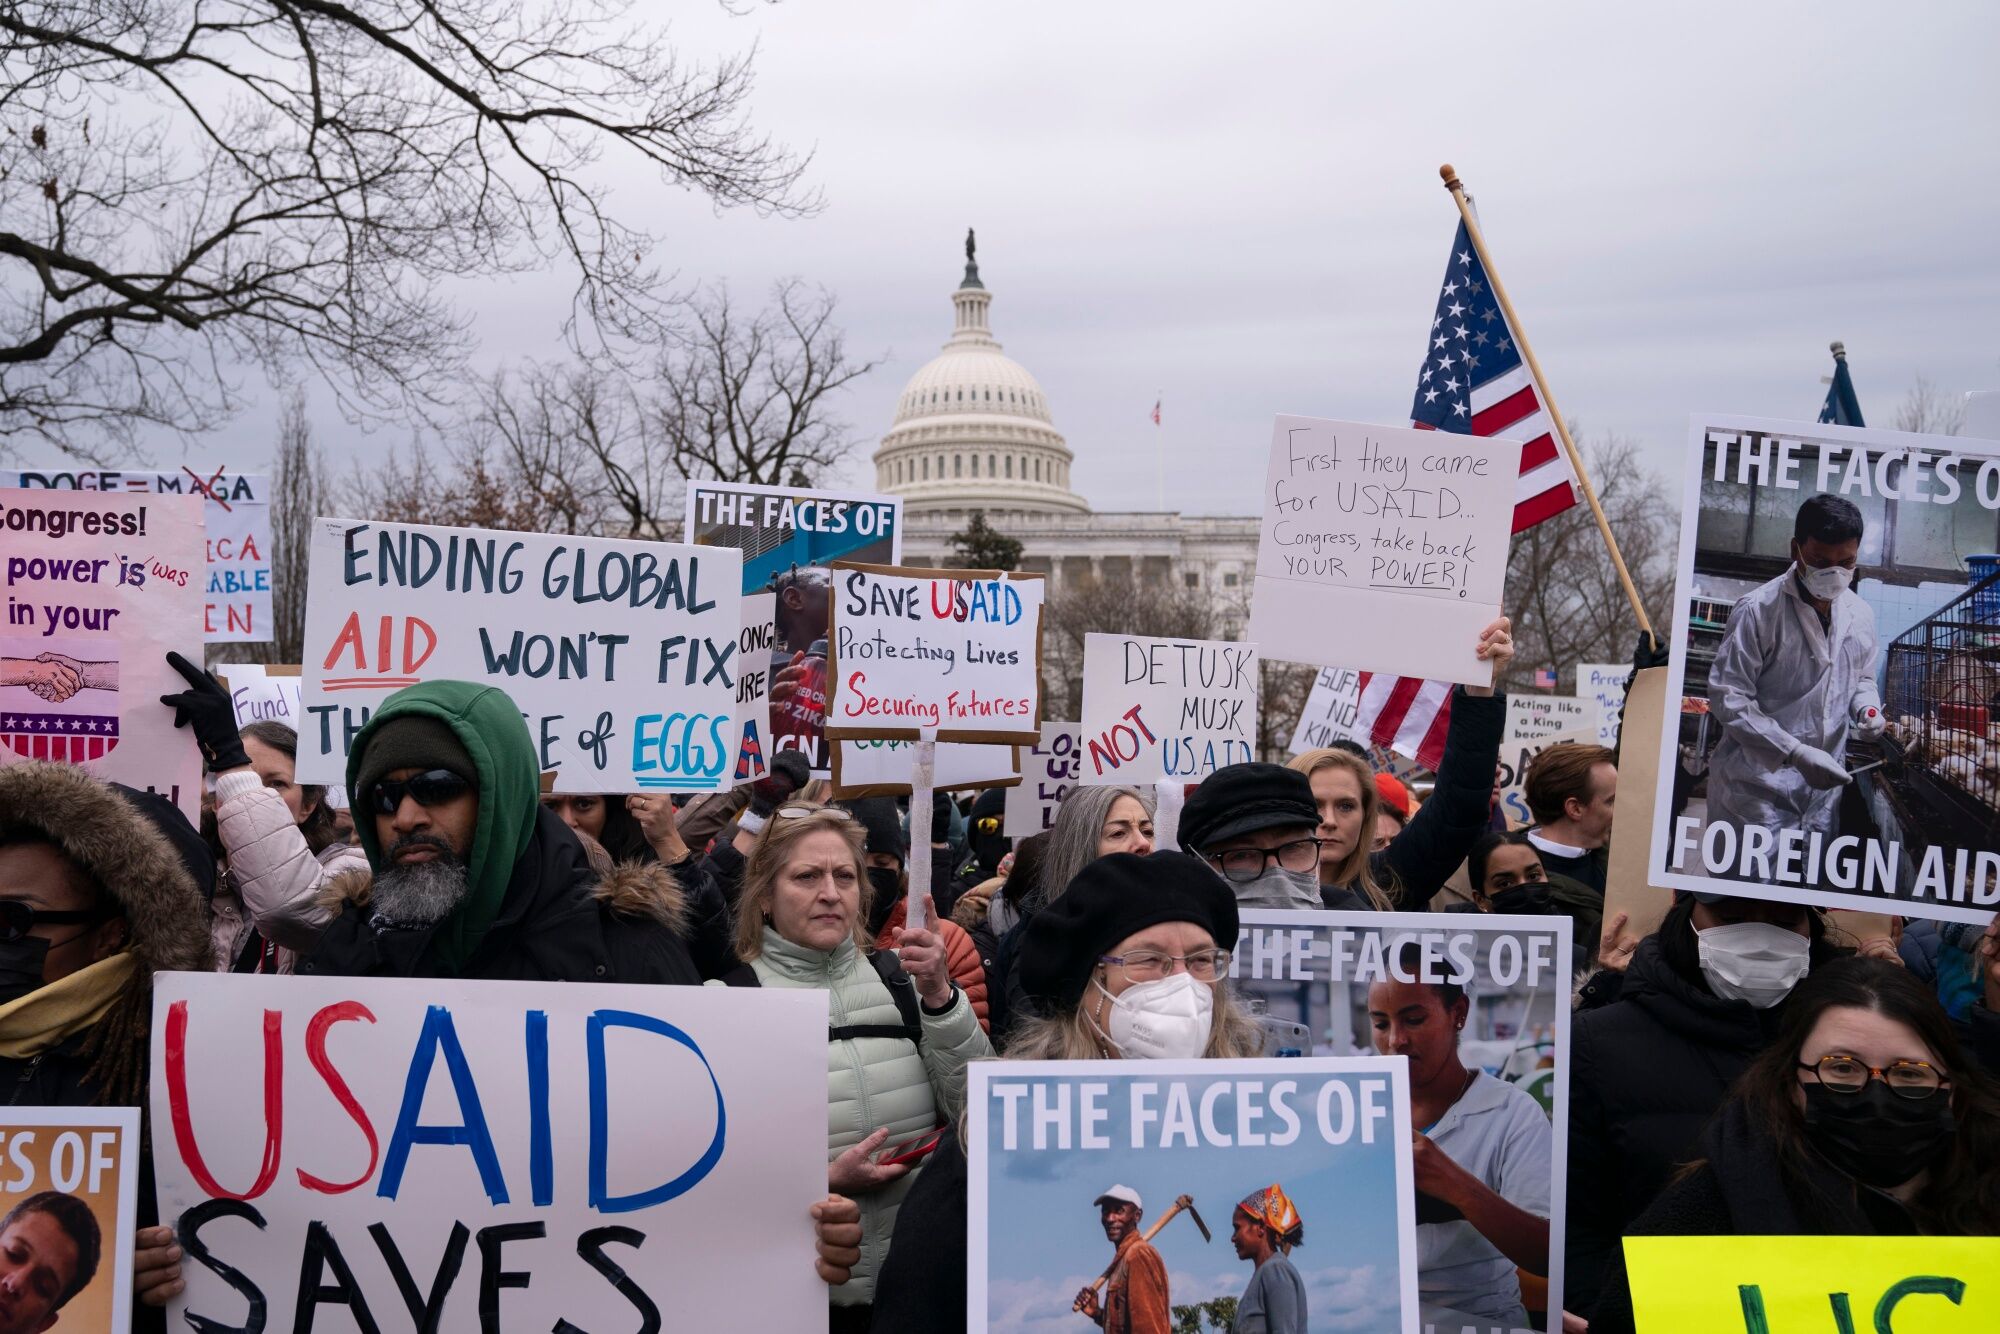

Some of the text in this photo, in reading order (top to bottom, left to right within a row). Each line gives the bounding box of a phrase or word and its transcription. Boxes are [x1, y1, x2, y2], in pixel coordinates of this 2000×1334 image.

[1289, 428, 1488, 491] First they came
[1708, 432, 1801, 490] THE
[1816, 443, 1961, 505] FACES
[698, 492, 891, 537] THE FACES OF
[1275, 480, 1318, 514] for
[0, 506, 146, 538] ongress!
[1273, 521, 1477, 562] Congress, take back
[8, 554, 109, 586] power
[152, 562, 189, 587] was
[206, 570, 269, 593] ABLE
[345, 525, 716, 615] ENDING GLOBAL
[1284, 555, 1468, 598] YOUR POWER!
[9, 597, 120, 636] in your
[846, 572, 1022, 626] SAVE USAID
[323, 611, 737, 690] AID WON'T FIX
[739, 622, 774, 654] ONG
[839, 625, 1019, 676] Protecting Lives
[1124, 641, 1255, 693] DETUSK
[232, 683, 290, 725] Fund
[845, 671, 1030, 727] Securing Futures
[1180, 696, 1244, 736] MUSK
[1327, 698, 1358, 729] NO
[1512, 699, 1582, 714] Acting like
[1520, 716, 1562, 729] a King
[306, 704, 369, 757] TH
[578, 711, 615, 770] of
[632, 712, 730, 777] EGGS
[1088, 703, 1156, 776] NOT
[1514, 729, 1551, 739] beca
[1671, 815, 2000, 906] FOREIGN AID
[1229, 928, 1552, 987] THE FACES OF
[164, 999, 727, 1213] USAID
[992, 1079, 1387, 1150] THE FACES OF
[50, 1131, 116, 1194] OF
